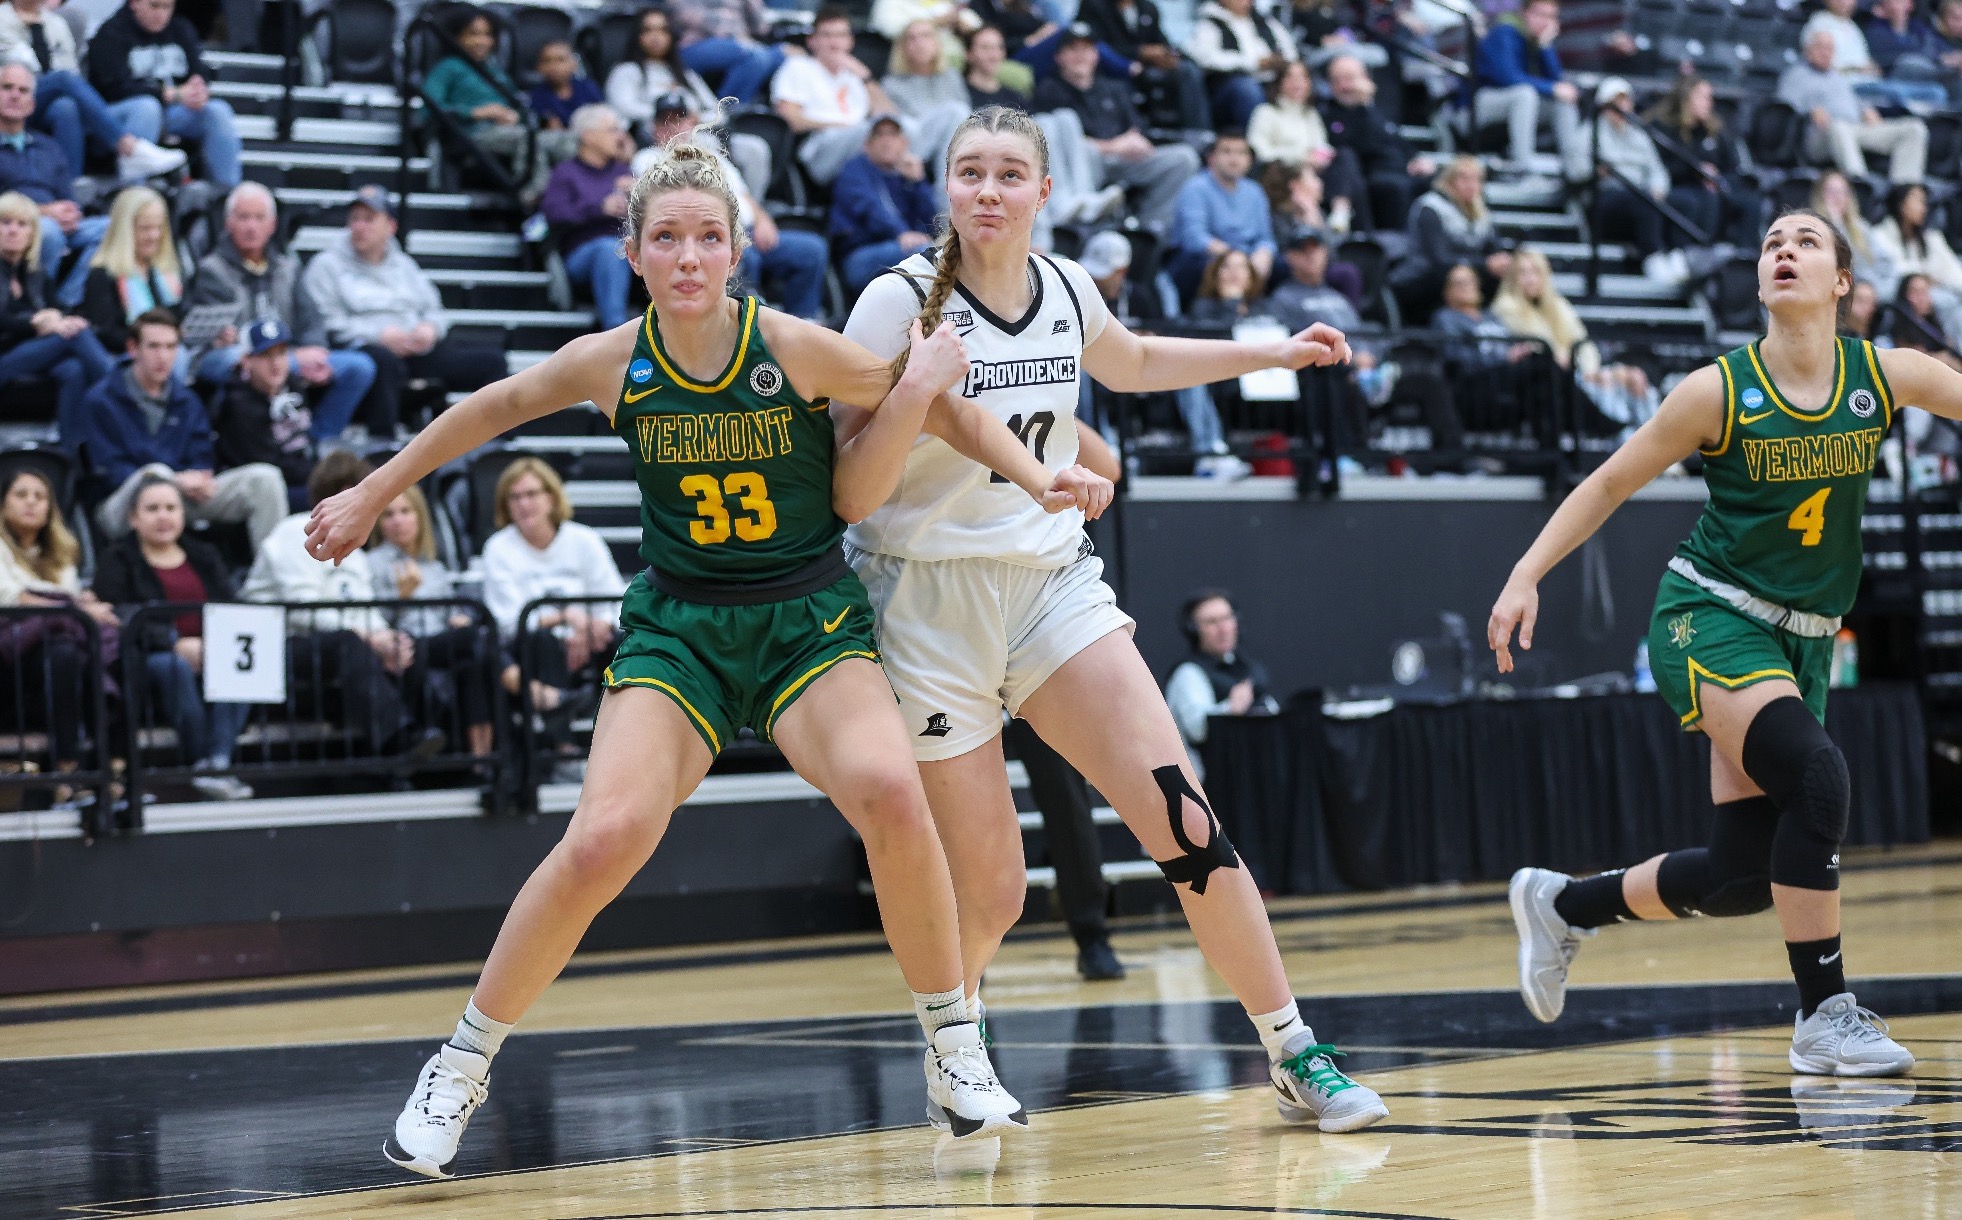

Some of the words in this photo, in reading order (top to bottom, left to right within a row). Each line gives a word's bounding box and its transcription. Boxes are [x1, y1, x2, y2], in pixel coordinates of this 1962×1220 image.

[962, 356, 1075, 398] PROVIDENCE
[636, 406, 792, 463] VERMONT
[1742, 427, 1882, 481] VERMONT
[680, 471, 778, 545] 33
[1788, 487, 1831, 546] 4
[235, 633, 255, 673] 3
